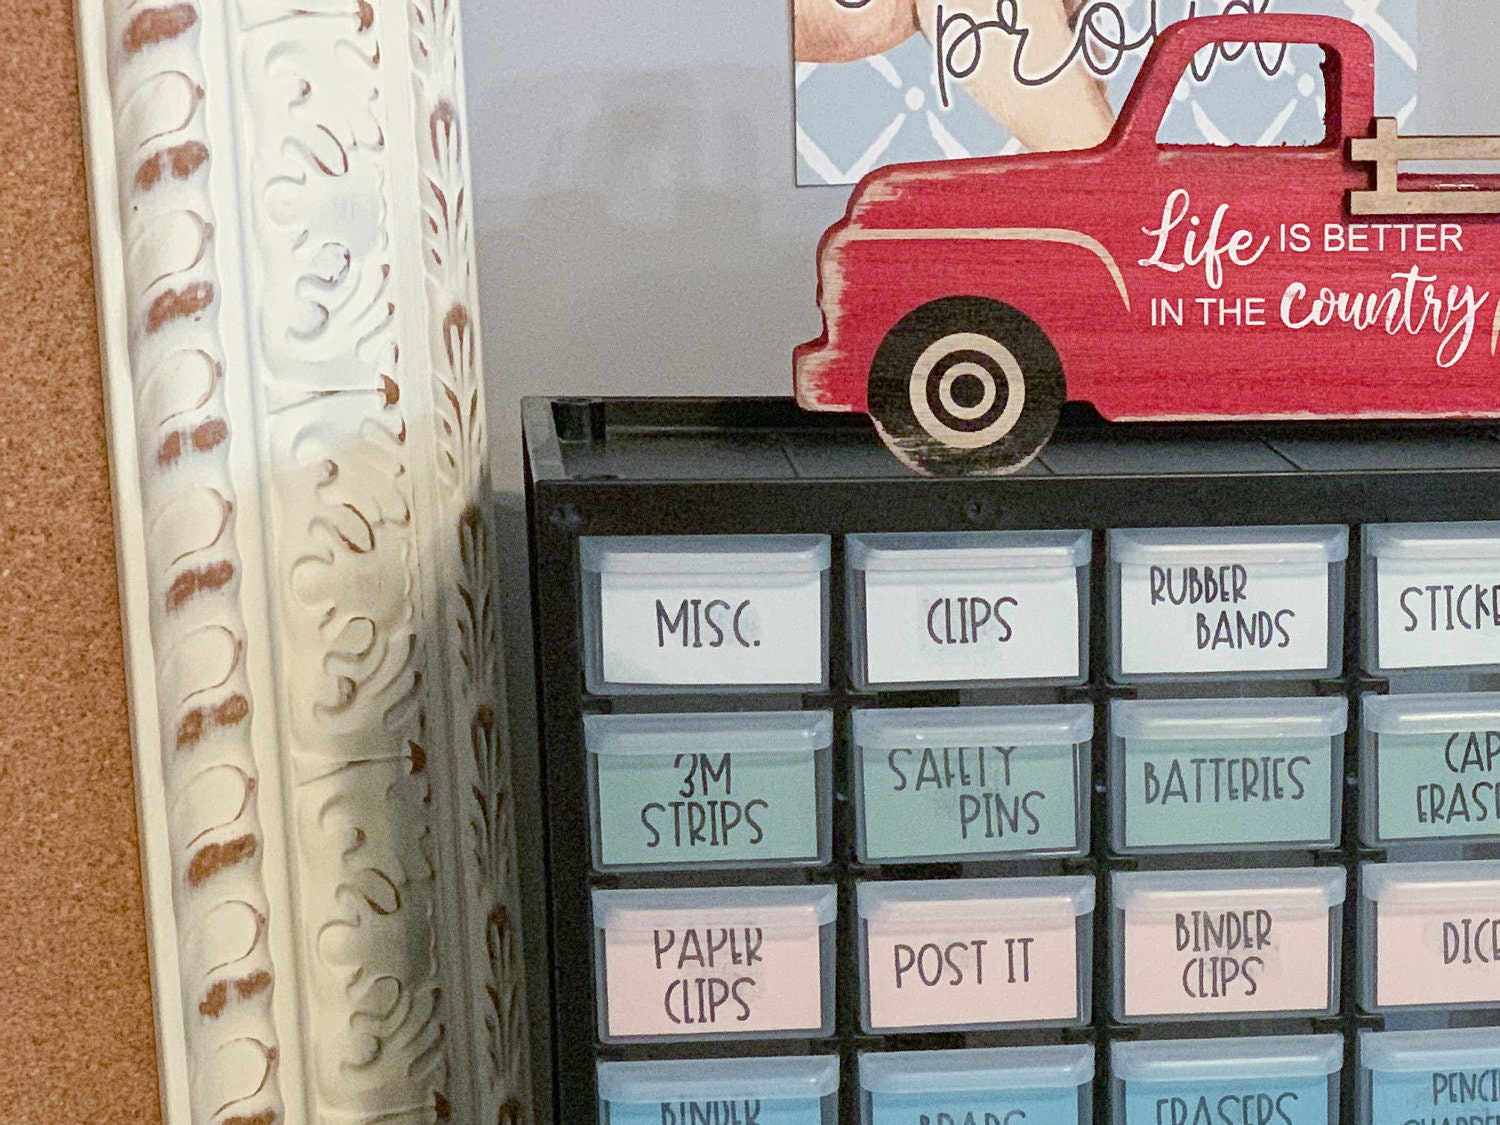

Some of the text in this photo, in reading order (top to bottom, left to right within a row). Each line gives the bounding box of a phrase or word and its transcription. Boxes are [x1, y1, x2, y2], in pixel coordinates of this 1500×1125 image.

[937, 0, 1287, 107] pro
[1139, 188, 1464, 290] Life IS BETTER
[1150, 265, 1489, 369] IN THE country
[1150, 565, 1246, 605] RUBBER
[656, 599, 761, 649] MISC.
[927, 597, 1018, 644] CLIPS
[1196, 609, 1295, 649] BANDS
[674, 752, 731, 797] 3M
[1144, 756, 1310, 804] BATTERIES
[641, 801, 768, 848] STRIPS
[959, 791, 1045, 839] PINS
[654, 928, 763, 969] PAPER
[1175, 910, 1272, 951] BINDER
[894, 938, 1034, 988] POST IT
[1182, 957, 1263, 998] CLIPS
[664, 978, 756, 1024] CLIPS
